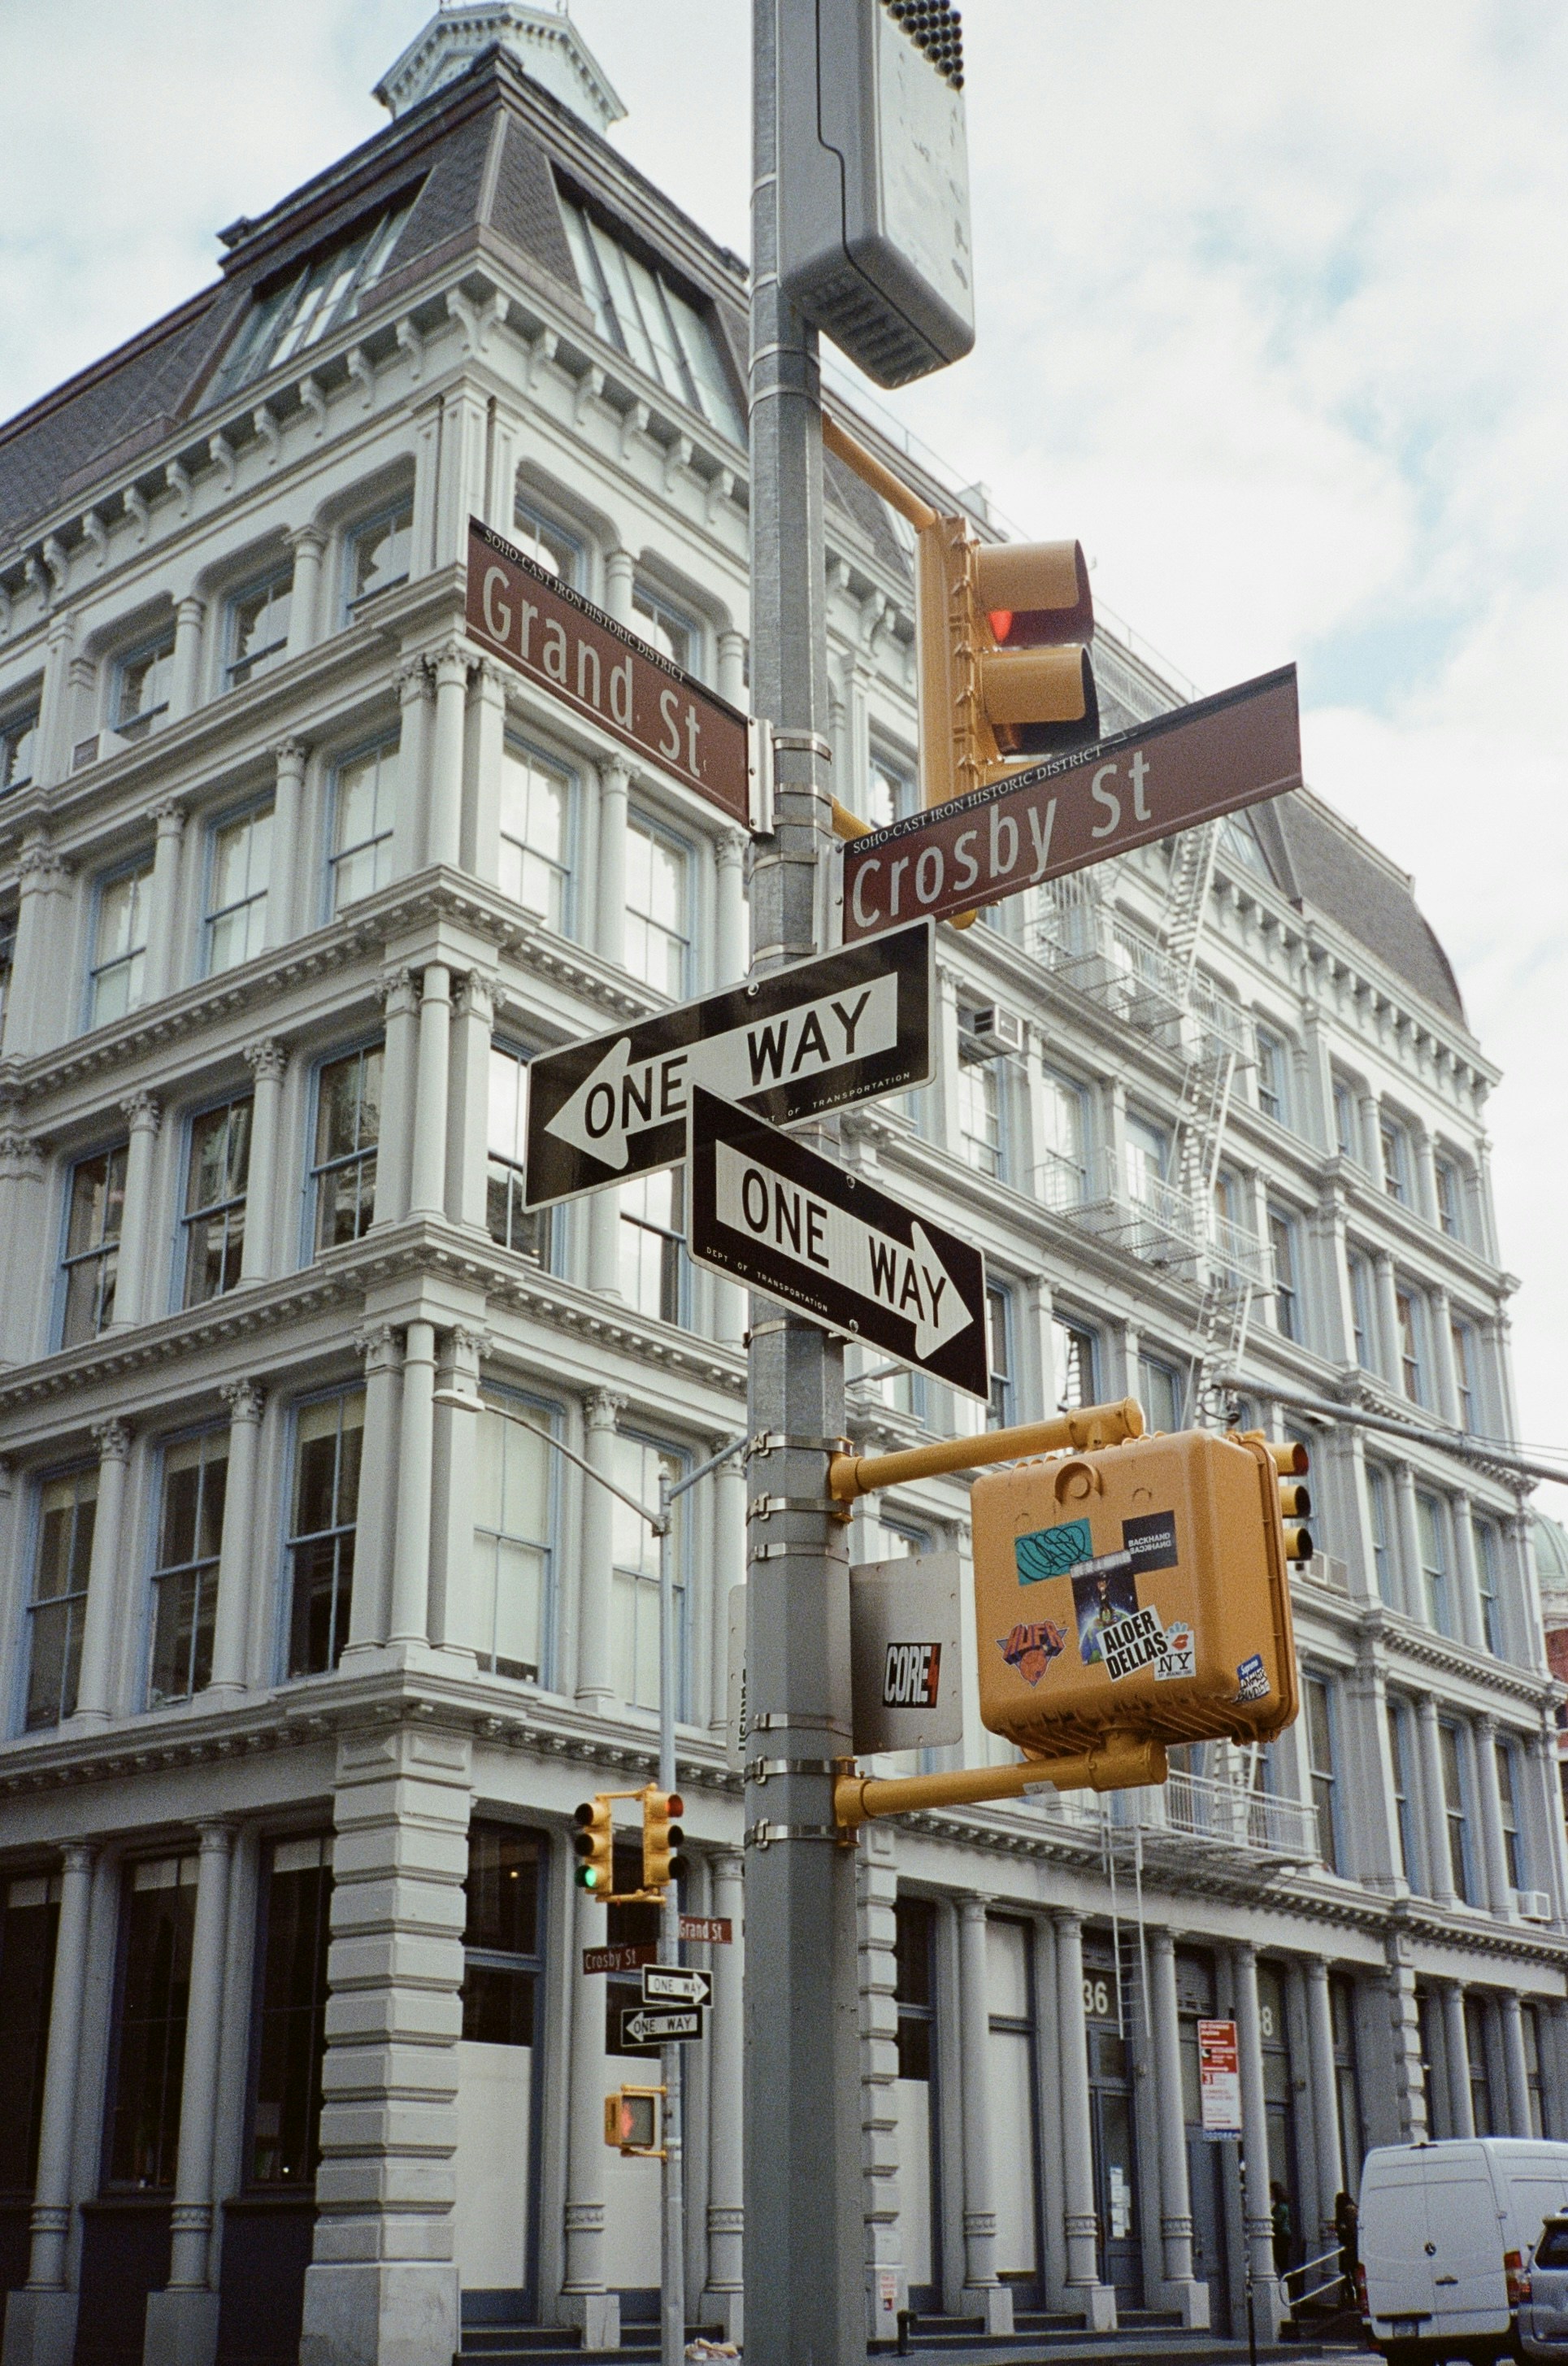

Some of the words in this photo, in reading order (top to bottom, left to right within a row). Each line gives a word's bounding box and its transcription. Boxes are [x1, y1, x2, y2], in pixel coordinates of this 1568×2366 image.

[485, 529, 552, 585] SOHO-CAST
[554, 580, 583, 608] IRON
[584, 600, 636, 647] HISTORIC
[637, 642, 686, 682] DISTRICT
[483, 566, 633, 732] Grand
[658, 689, 701, 778] St
[853, 813, 928, 854] SOHO-CAST
[930, 799, 965, 823] IRON
[966, 771, 1034, 808] HISTORIC
[1036, 745, 1104, 781] DISTRICT
[852, 798, 1058, 929] Crosby
[1091, 750, 1153, 839] St
[584, 1054, 688, 1139] ONE
[746, 989, 872, 1087] WAY
[788, 1107, 801, 1116] OF
[813, 1072, 910, 1109] TRANSPORTATION
[741, 1168, 830, 1269] ONE
[867, 1235, 948, 1329] WAY
[706, 1246, 728, 1263] DEPT
[737, 1262, 748, 1272] OF
[757, 1272, 828, 1313] TRANSPORTATION
[1127, 1532, 1171, 1547] BACKHAND
[884, 1646, 932, 1703] CORE
[1105, 1631, 1168, 1680] DELLAS
[1158, 1651, 1192, 1672] NY
[680, 1920, 709, 1940] Grand
[712, 1923, 723, 1942] St
[585, 1951, 621, 1971] Crosby
[625, 1948, 636, 1966] St
[654, 1977, 674, 1993] ONE
[682, 1981, 703, 1994] WAY
[1083, 1979, 1108, 2015] 36
[633, 2019, 656, 2034] ONE
[667, 2016, 693, 2031] WAY
